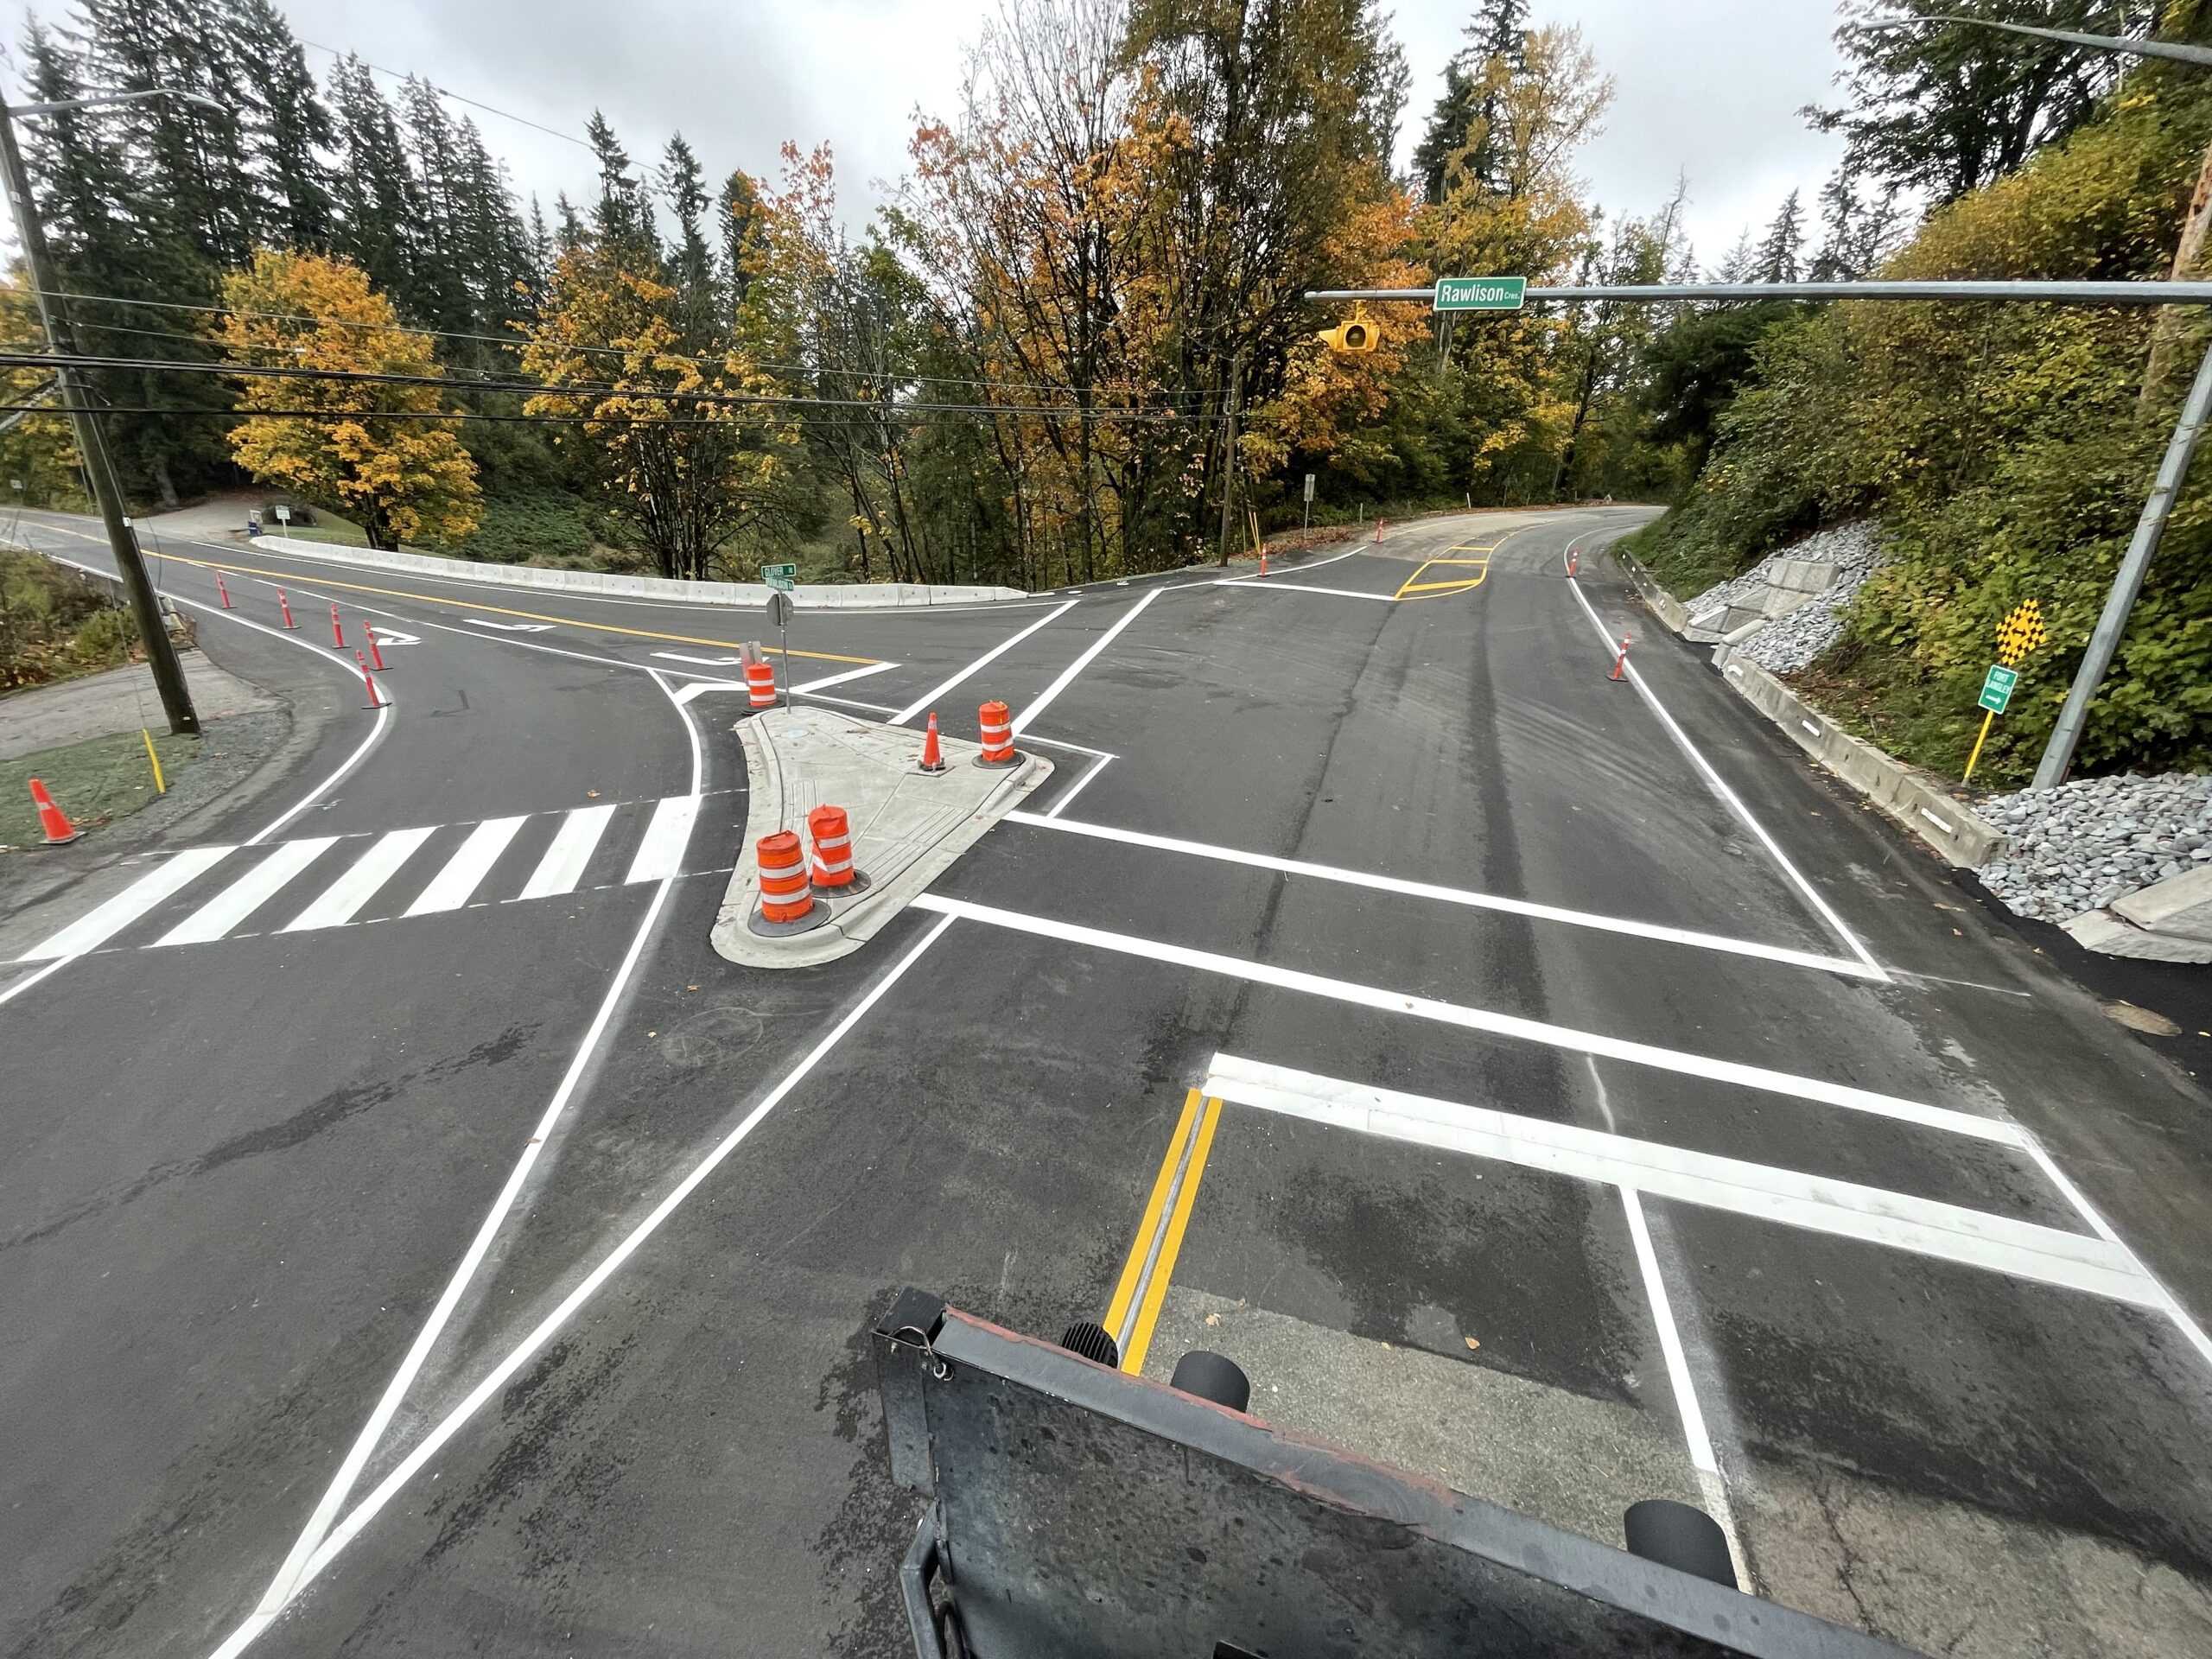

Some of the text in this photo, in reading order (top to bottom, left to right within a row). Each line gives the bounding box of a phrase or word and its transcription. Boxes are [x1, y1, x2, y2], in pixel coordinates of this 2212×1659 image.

[1441, 284, 1503, 302] Rawlison
[765, 567, 783, 577] GLOVER
[1993, 671, 2010, 683] FORT
[1986, 678, 2012, 694] LANGLEY
